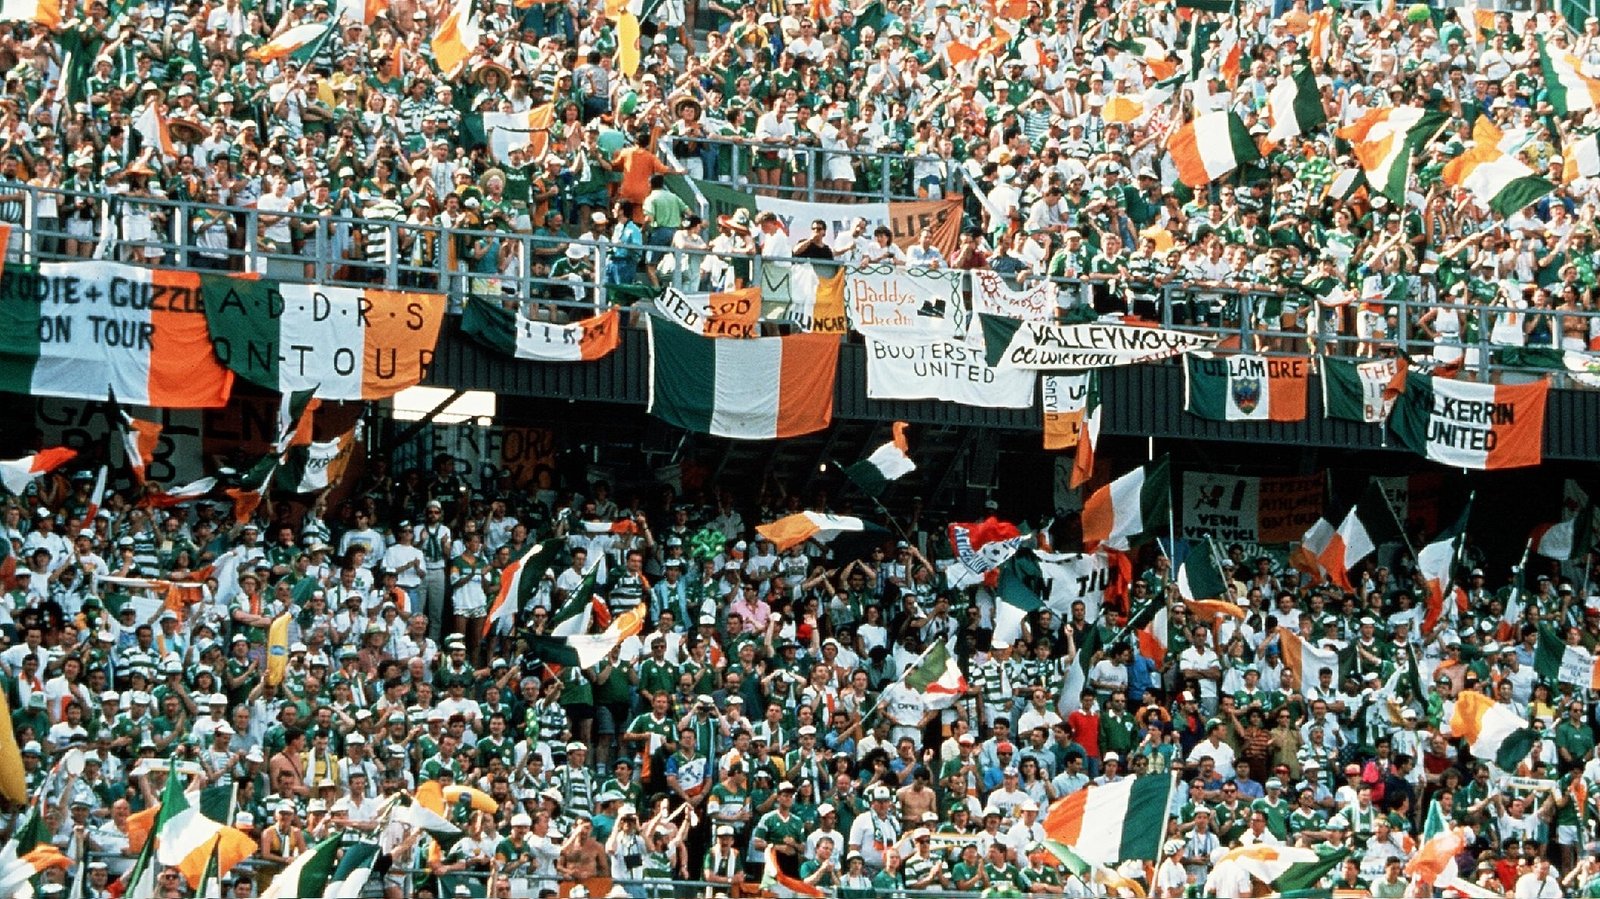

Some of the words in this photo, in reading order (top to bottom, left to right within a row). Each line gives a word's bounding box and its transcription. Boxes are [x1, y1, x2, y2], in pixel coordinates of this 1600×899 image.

[37, 316, 71, 343] ON
[87, 315, 155, 350] TOUR
[1027, 322, 1217, 349] VALLEYMOUNT
[914, 361, 995, 384] UNITED
[1193, 360, 1304, 379] TULLAMORE
[1359, 361, 1394, 379] THE
[1426, 420, 1498, 451] UNITED
[1198, 514, 1239, 527] VENI
